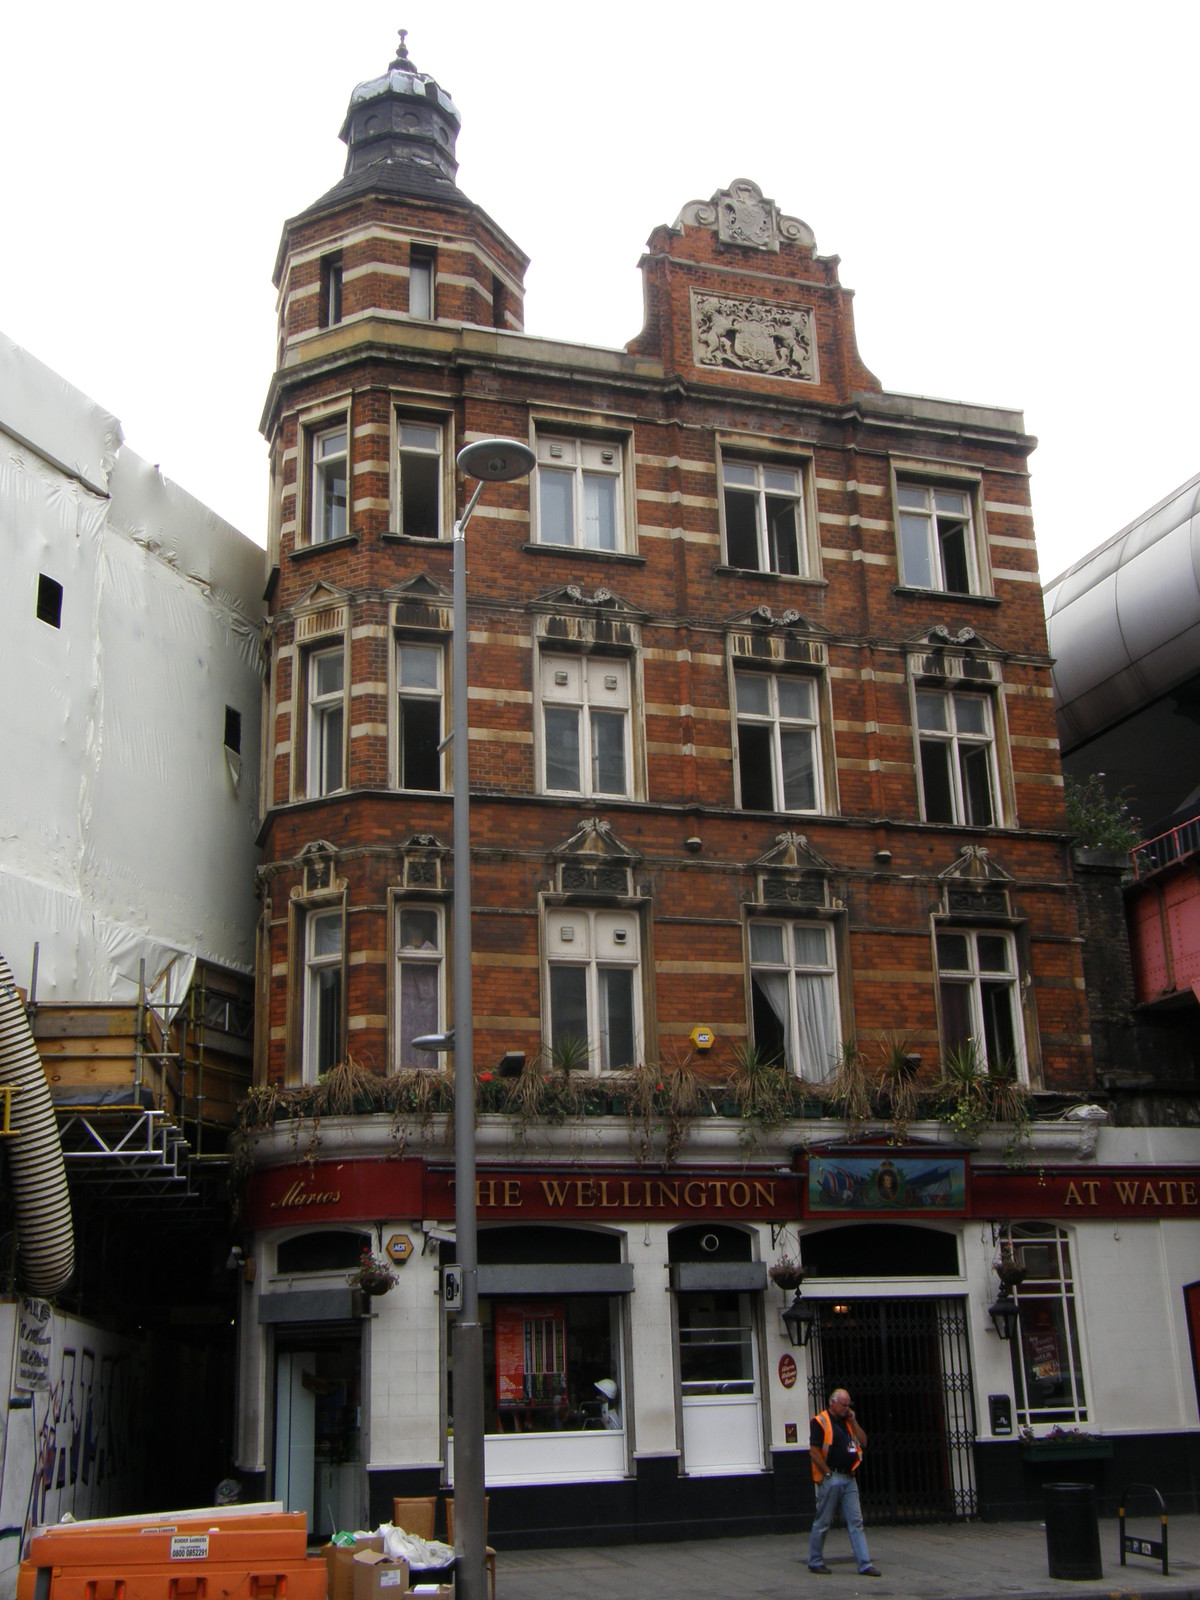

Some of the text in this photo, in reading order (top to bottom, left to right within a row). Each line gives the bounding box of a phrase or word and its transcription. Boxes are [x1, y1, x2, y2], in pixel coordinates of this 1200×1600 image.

[270, 1181, 341, 1207] Marios
[540, 1180, 777, 1208] WELLINGTON
[1064, 1181, 1101, 1206] AT
[393, 1243, 406, 1251] ADT
[172, 1549, 185, 1557] 0800
